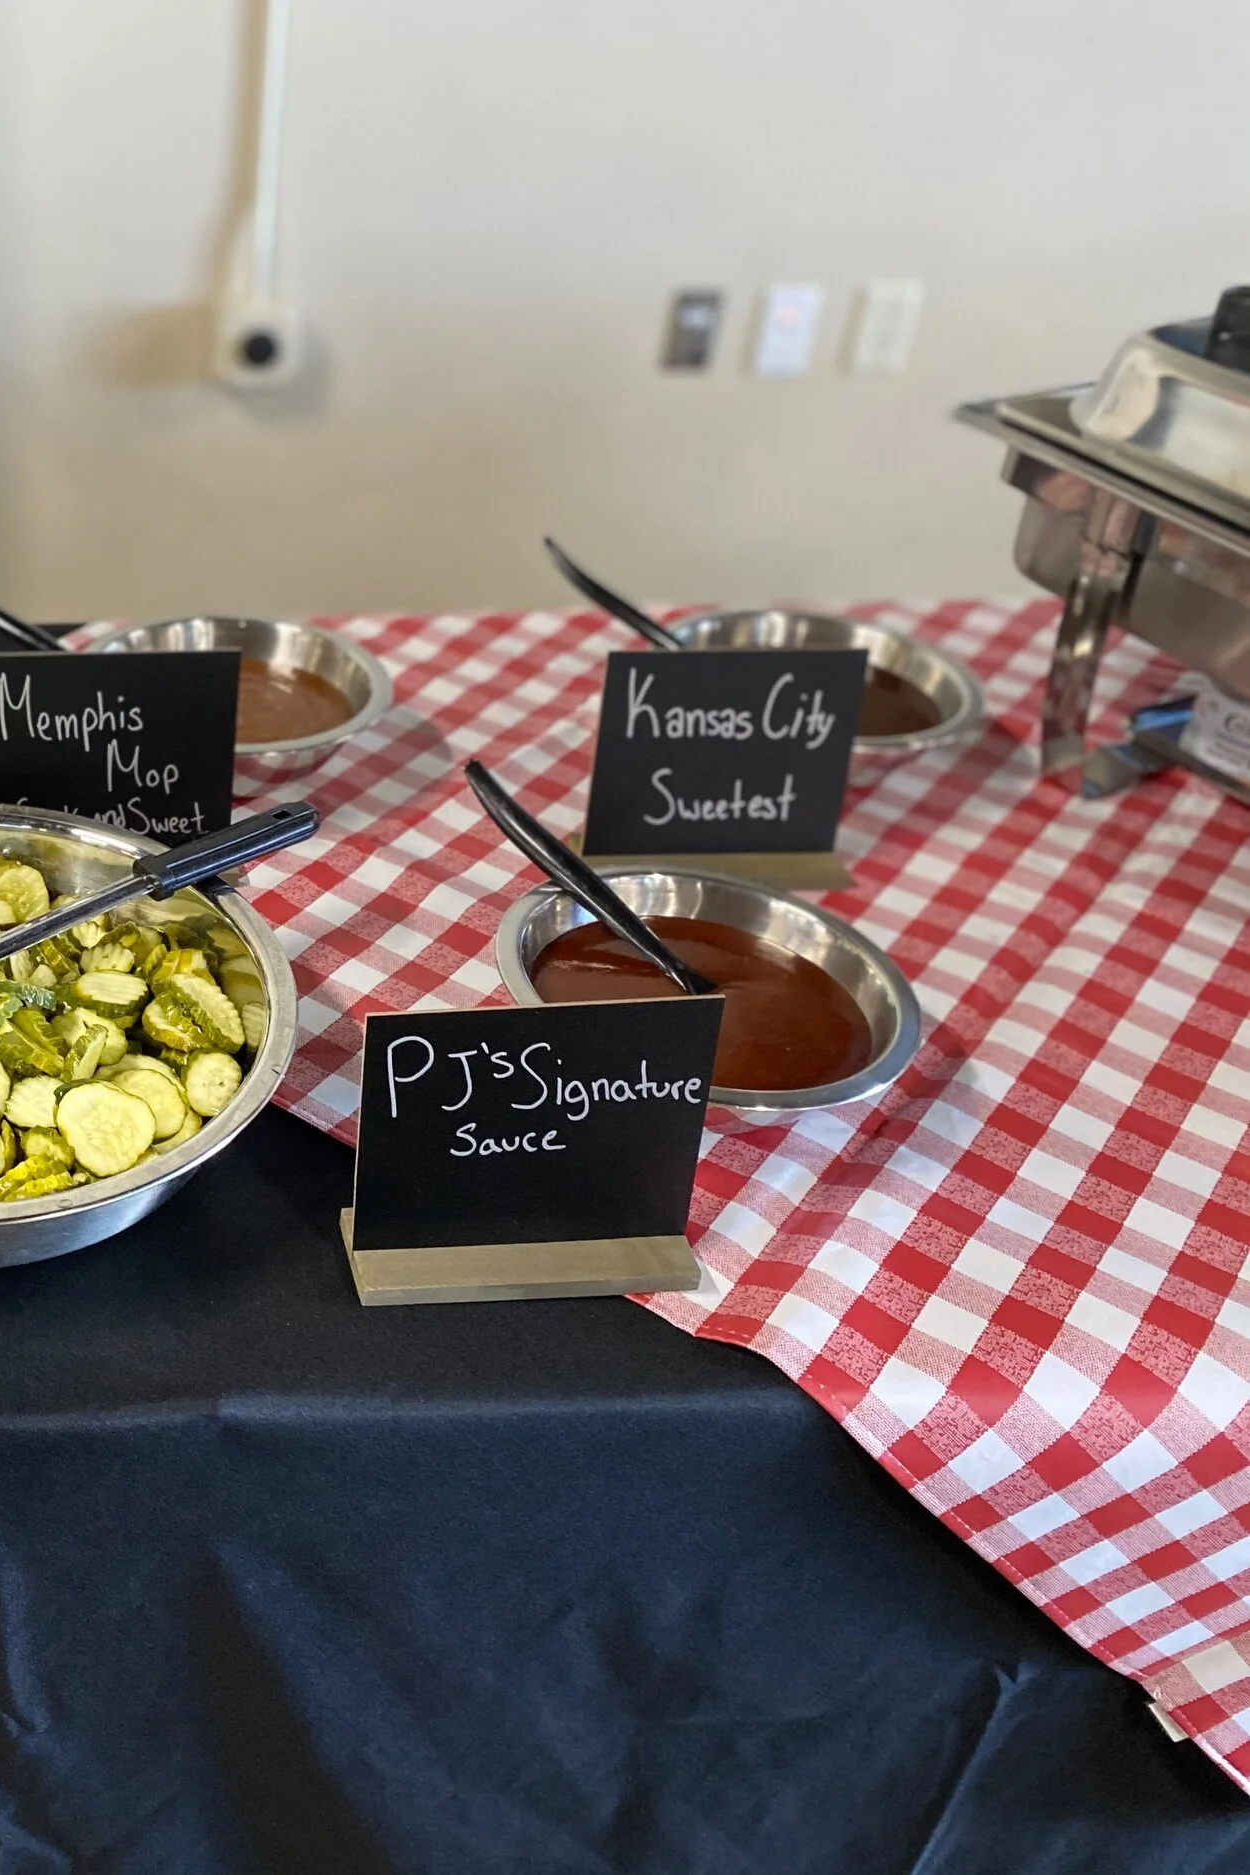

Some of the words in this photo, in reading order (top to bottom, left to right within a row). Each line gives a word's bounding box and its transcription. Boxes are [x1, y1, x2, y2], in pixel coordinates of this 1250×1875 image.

[0, 672, 144, 752] Memphis
[626, 667, 754, 740] Kansas
[762, 672, 836, 750] City
[106, 739, 180, 794] Mop
[127, 797, 209, 836] Sweet
[643, 767, 797, 826] Sweetest
[386, 1035, 515, 1118] PJ's
[511, 1042, 703, 1121] Signature
[449, 1122, 567, 1157] Sauce
